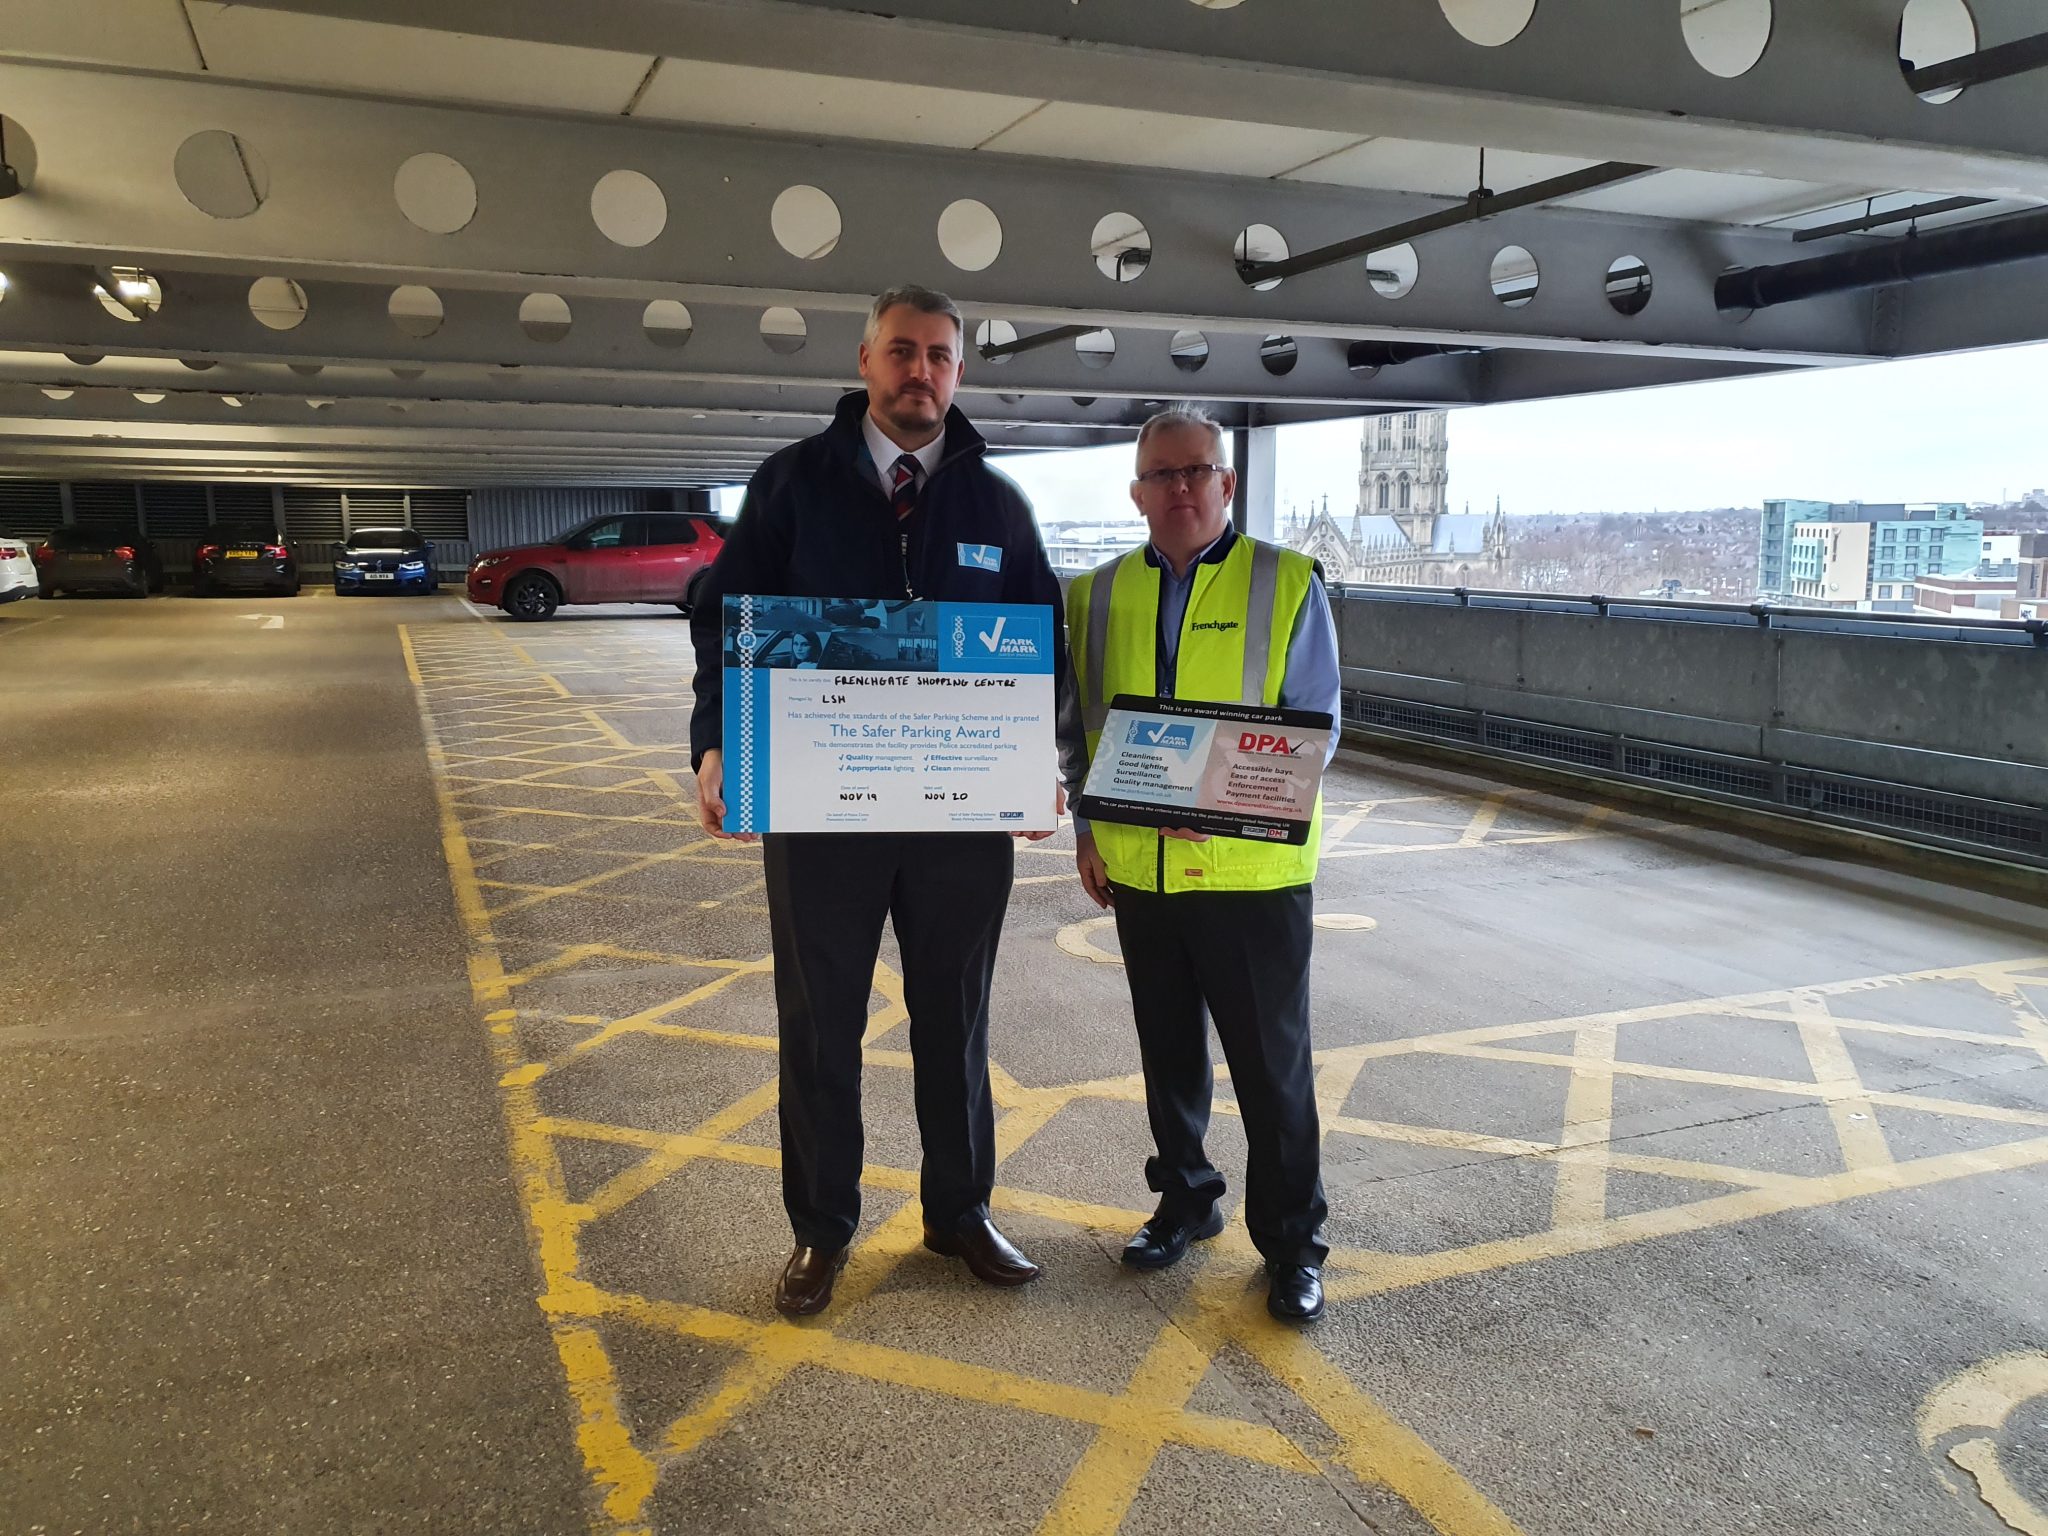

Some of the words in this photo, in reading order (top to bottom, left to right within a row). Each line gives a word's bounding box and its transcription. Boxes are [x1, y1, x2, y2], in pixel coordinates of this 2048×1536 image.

[1191, 620, 1239, 631] Frenchgate
[1001, 638, 1034, 646] PARK
[999, 645, 1038, 653] MARK
[834, 675, 910, 686] FRENCHGATE
[917, 676, 968, 687] SHOPPING
[974, 678, 1018, 687] CENTRE
[822, 694, 846, 704] LSH
[788, 711, 802, 719] Has
[804, 711, 836, 719] achieved
[853, 712, 887, 720] standards
[899, 712, 911, 720] the
[933, 713, 960, 722] Parking
[961, 713, 988, 721] Scheme
[1013, 714, 1040, 723] granted
[1194, 708, 1218, 716] award
[1219, 711, 1250, 719] winning
[1264, 714, 1283, 722] park
[829, 723, 857, 737] The
[862, 724, 897, 738] Safer
[901, 725, 951, 741] Parking
[956, 726, 1000, 739] Award
[813, 740, 827, 748] This
[875, 741, 886, 749] the
[887, 741, 908, 750] facility
[910, 742, 937, 750] provides
[994, 743, 1018, 751] parking
[1238, 732, 1290, 755] DPA
[845, 754, 873, 762] Quality
[875, 754, 913, 762] management
[1121, 751, 1163, 761] Cleanliness
[845, 764, 892, 773] Appropriate
[893, 765, 915, 773] lighting
[1118, 760, 1140, 768] Good
[1140, 763, 1169, 772] lighting
[1232, 763, 1273, 773] Accessible
[1275, 767, 1293, 776] bays
[1116, 768, 1162, 779] Surveillance
[1230, 772, 1248, 780] Ease
[1260, 776, 1286, 784] access
[1113, 777, 1141, 787] Quality
[1142, 781, 1193, 792] management
[1228, 780, 1279, 792] Enforcement
[839, 792, 863, 801] NOV
[867, 792, 878, 801] 19
[924, 792, 945, 801] NOV
[952, 792, 969, 801] 20
[1225, 789, 1261, 800] Payment
[1262, 793, 1296, 804] facilities
